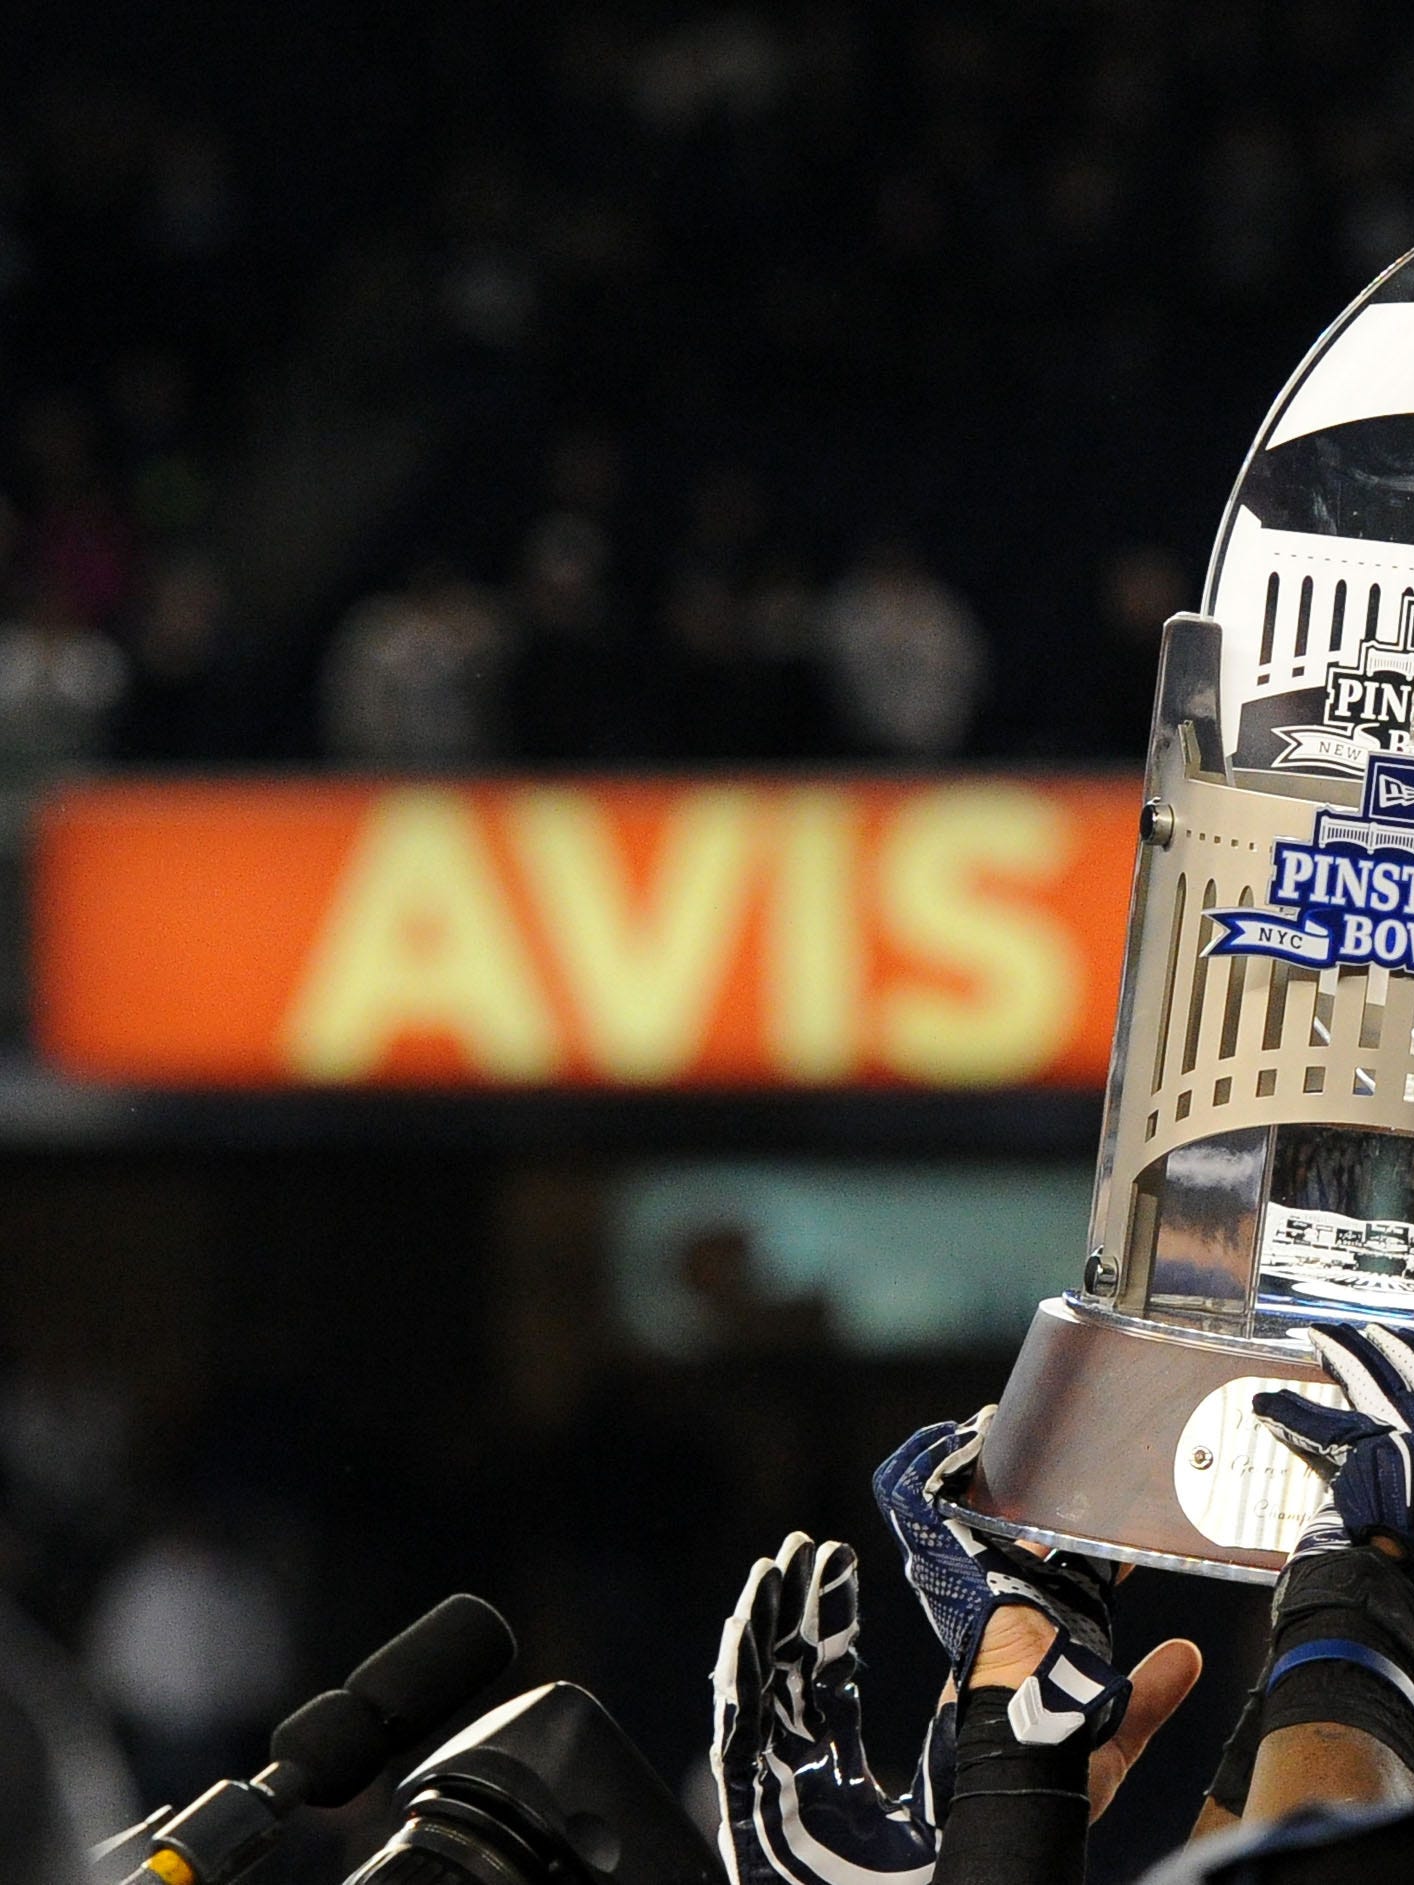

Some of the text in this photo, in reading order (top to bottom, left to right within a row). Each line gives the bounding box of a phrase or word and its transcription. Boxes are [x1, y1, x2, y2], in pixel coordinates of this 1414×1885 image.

[1319, 741, 1362, 761] NEW
[278, 784, 1084, 1088] AVIS
[1257, 926, 1303, 950] NYC
